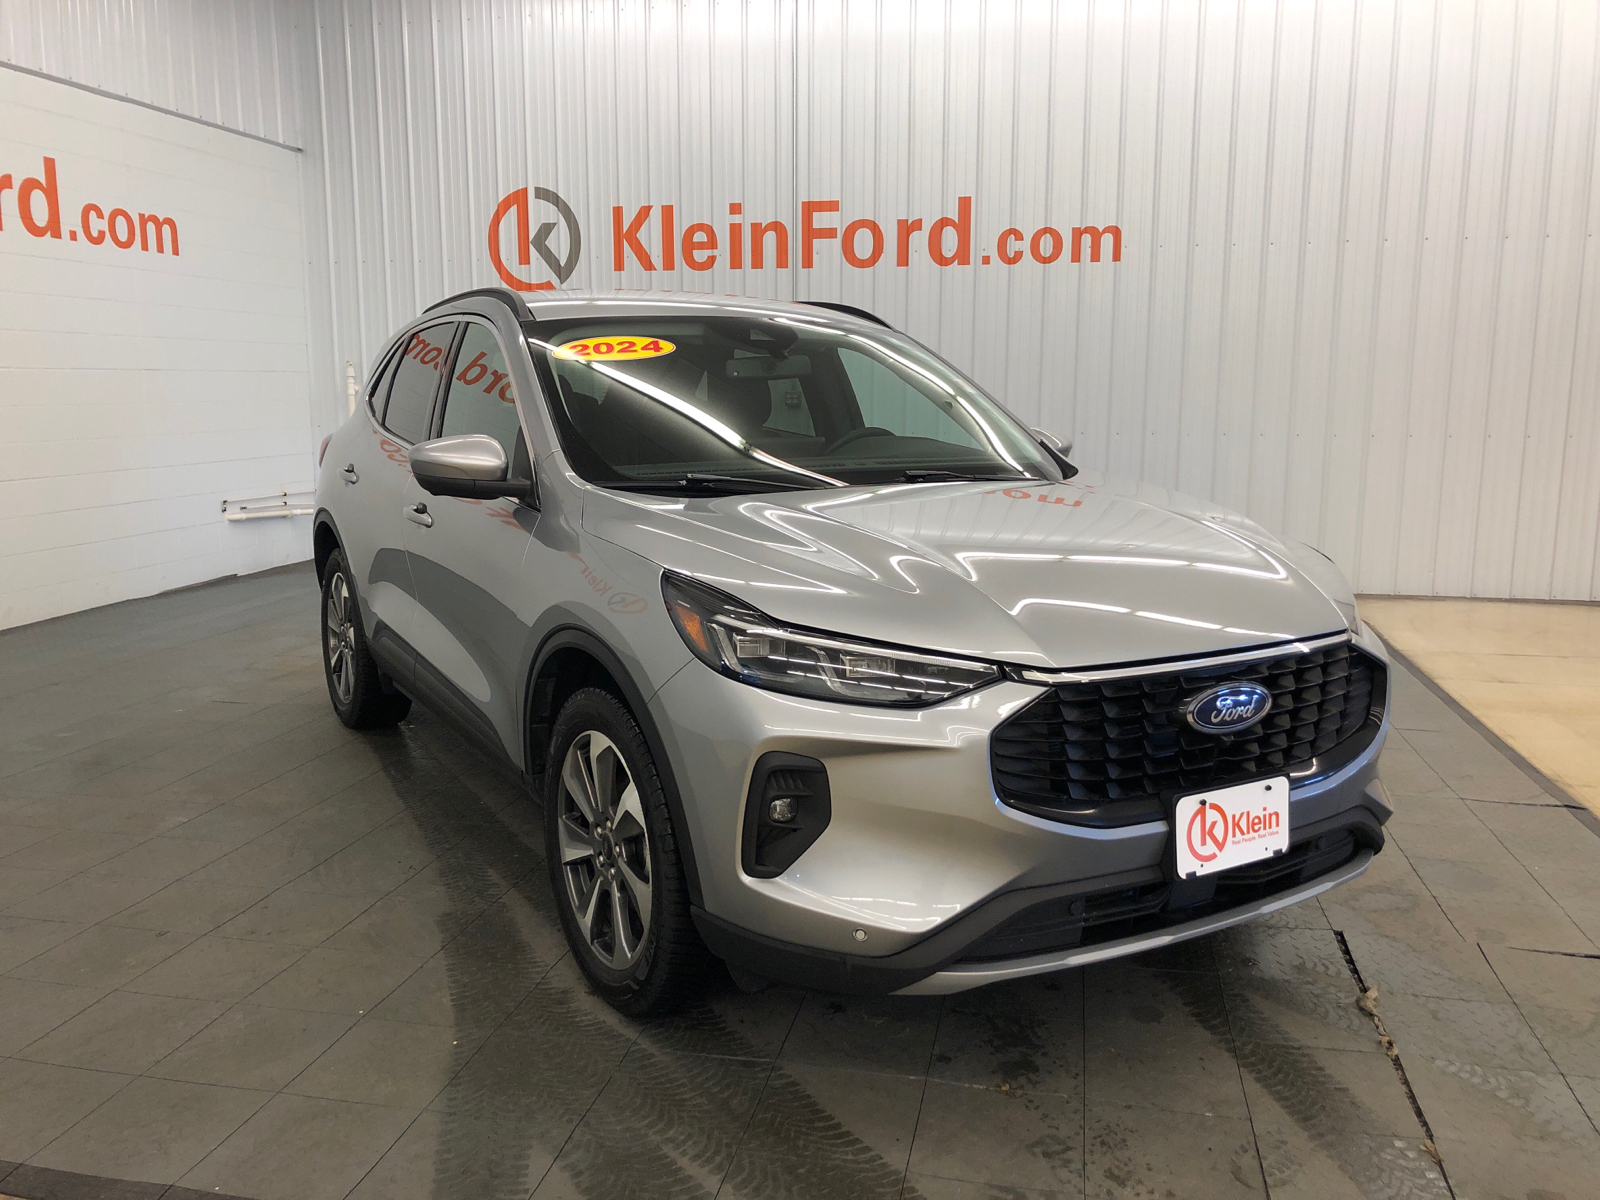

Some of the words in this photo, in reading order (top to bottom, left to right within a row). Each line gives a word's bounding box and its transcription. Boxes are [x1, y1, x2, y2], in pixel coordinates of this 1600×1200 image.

[612, 196, 1123, 271] KleinFord.com
[568, 339, 664, 357] 2024
[1211, 694, 1259, 723] Ford
[1231, 806, 1280, 839] Klein
